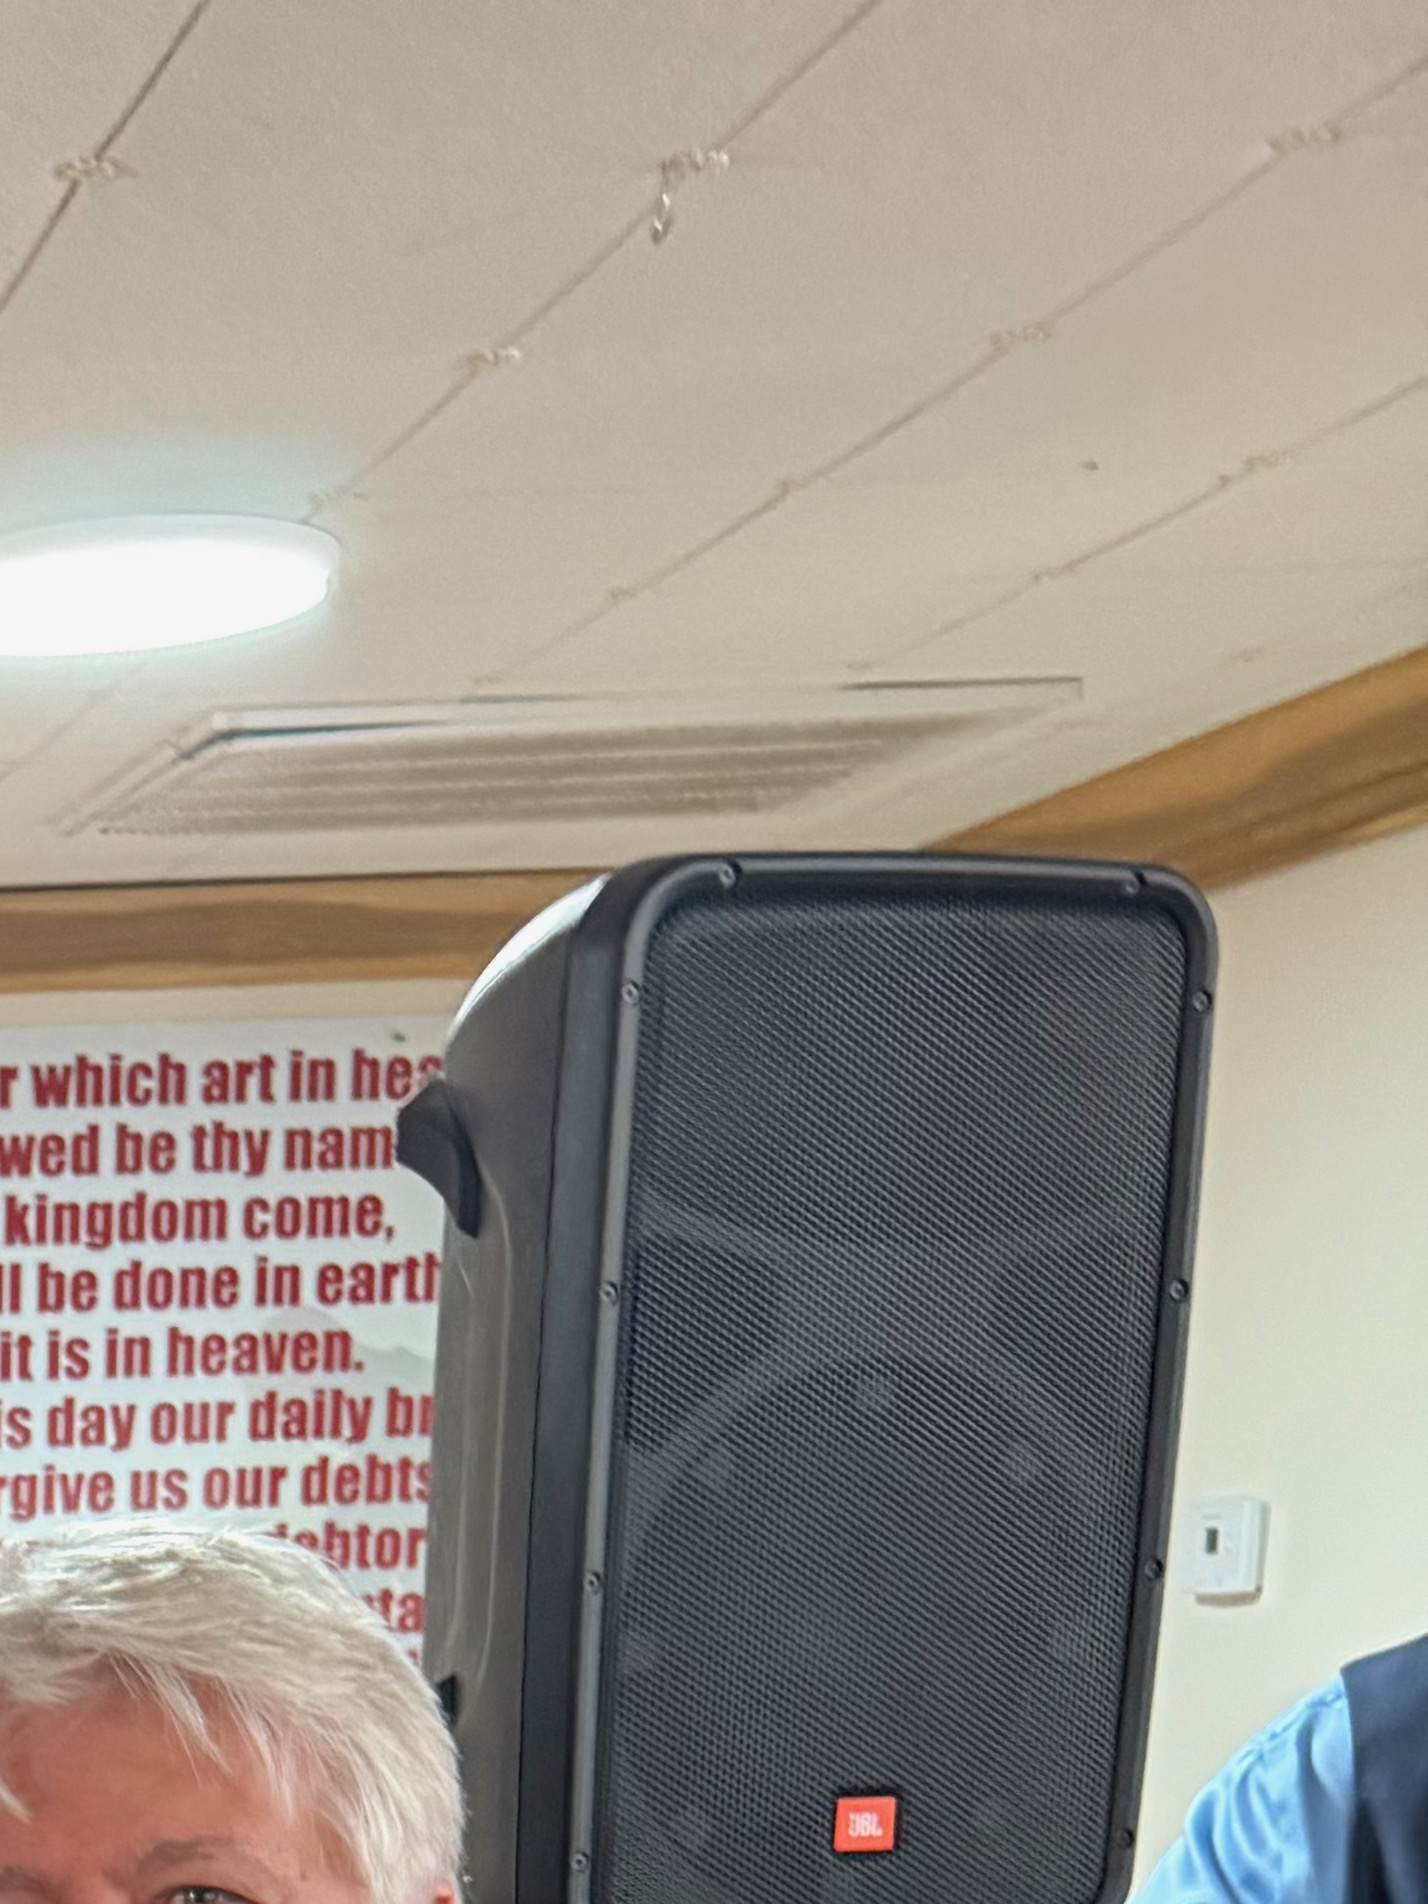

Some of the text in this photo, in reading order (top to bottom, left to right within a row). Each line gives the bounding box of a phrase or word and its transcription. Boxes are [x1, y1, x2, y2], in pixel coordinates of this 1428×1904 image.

[32, 1054, 186, 1107] which
[202, 1055, 275, 1104] art
[290, 1051, 336, 1101] in
[116, 1124, 176, 1174] be
[192, 1122, 270, 1176] thy
[5, 1192, 227, 1250] kingdom
[244, 1195, 393, 1239] come,
[38, 1263, 98, 1312] be
[114, 1261, 239, 1310] done
[256, 1258, 301, 1307] in
[0, 1332, 32, 1381] it
[48, 1331, 89, 1379] is
[106, 1329, 151, 1377] in
[168, 1326, 362, 1376] heaven.
[48, 1397, 135, 1449] day
[151, 1402, 235, 1443] our
[250, 1388, 372, 1443] daily
[131, 1470, 186, 1510] us
[204, 1467, 287, 1507] our
[848, 1812, 883, 1838] JBL
